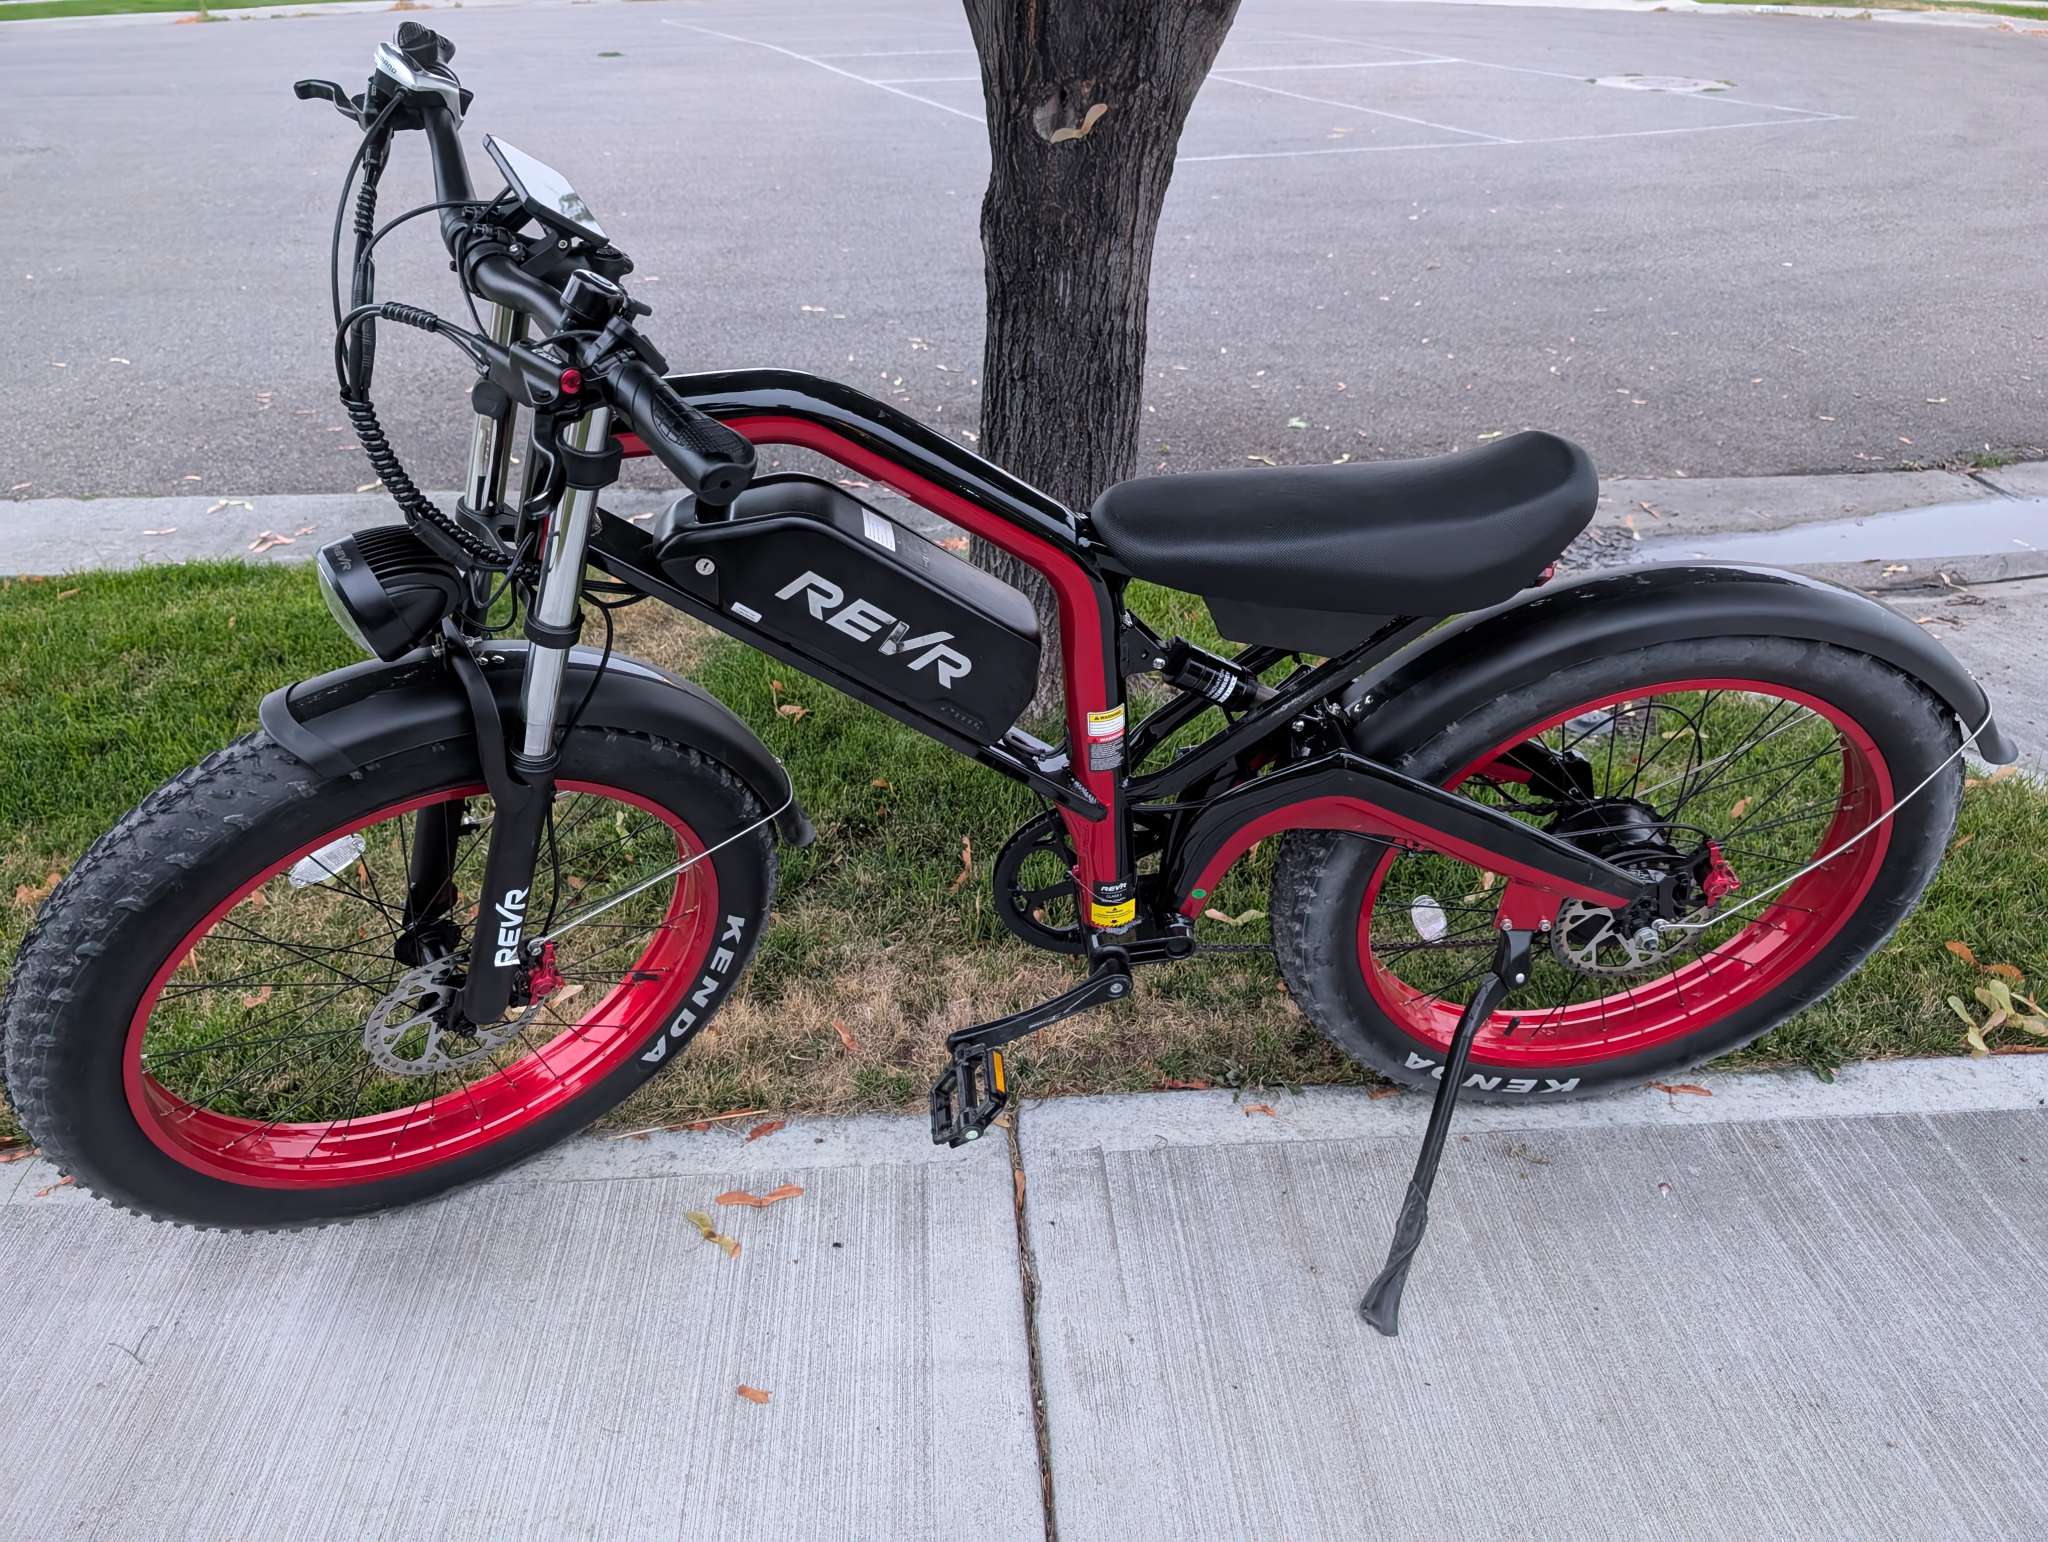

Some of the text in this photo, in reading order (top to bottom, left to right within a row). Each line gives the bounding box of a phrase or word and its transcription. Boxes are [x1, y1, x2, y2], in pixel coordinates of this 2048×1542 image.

[774, 570, 972, 689] REVR
[494, 886, 529, 967] REVR
[1101, 882, 1127, 892] REVR
[641, 914, 746, 1062] KENDA
